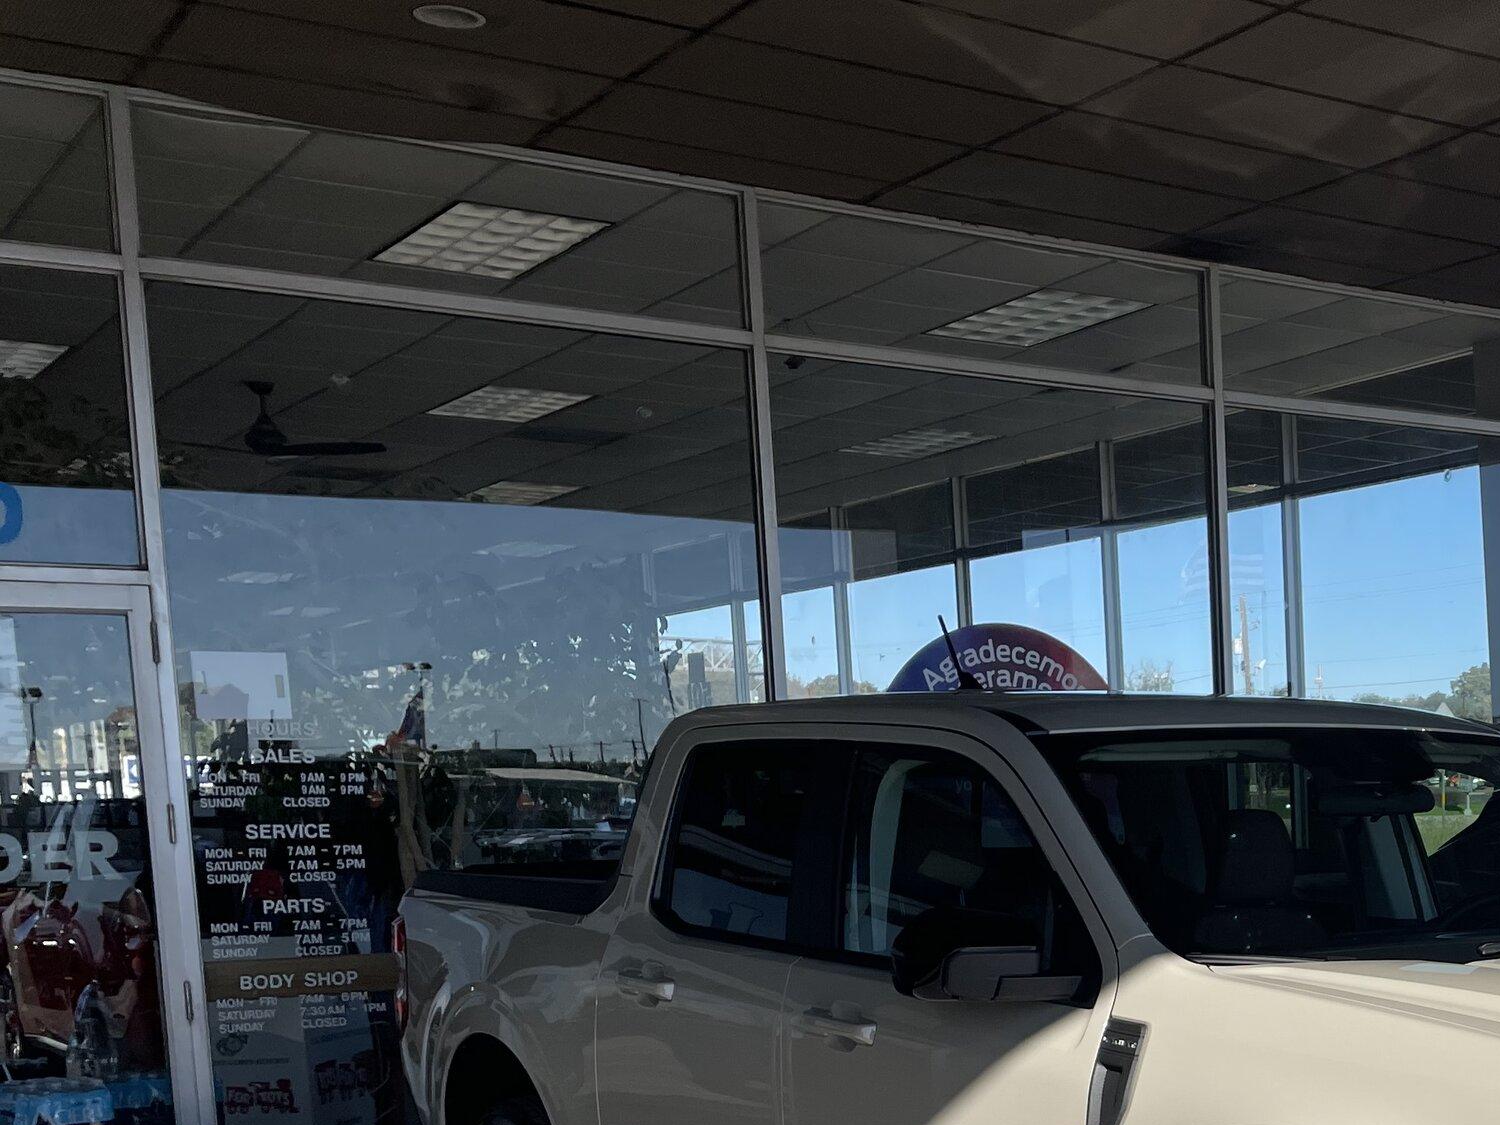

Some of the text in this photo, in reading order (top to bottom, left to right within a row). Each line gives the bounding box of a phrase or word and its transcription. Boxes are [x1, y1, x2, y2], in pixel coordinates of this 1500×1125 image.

[248, 721, 316, 736] HOURS
[252, 748, 316, 764] SALES
[242, 771, 261, 784] FRI
[200, 785, 258, 797] SATURDAY
[200, 796, 331, 809] SUNDAY CLOSED
[245, 823, 332, 840] SERVICE
[204, 848, 233, 860] MON
[249, 847, 267, 859] FRI
[205, 860, 266, 872] SATURDAY
[206, 871, 337, 885] SUNDAY CLOSED
[262, 898, 326, 915] PARTS
[210, 922, 239, 934] MON
[253, 921, 273, 932] FRI
[211, 934, 271, 946] SATURDAY
[212, 945, 343, 959] SUNDAY CLOSED
[240, 970, 358, 991] BODY SHOP
[216, 997, 244, 1009] MON
[218, 1008, 277, 1022] SATURDAY
[218, 1016, 348, 1034] SUNDAY CLOSED
